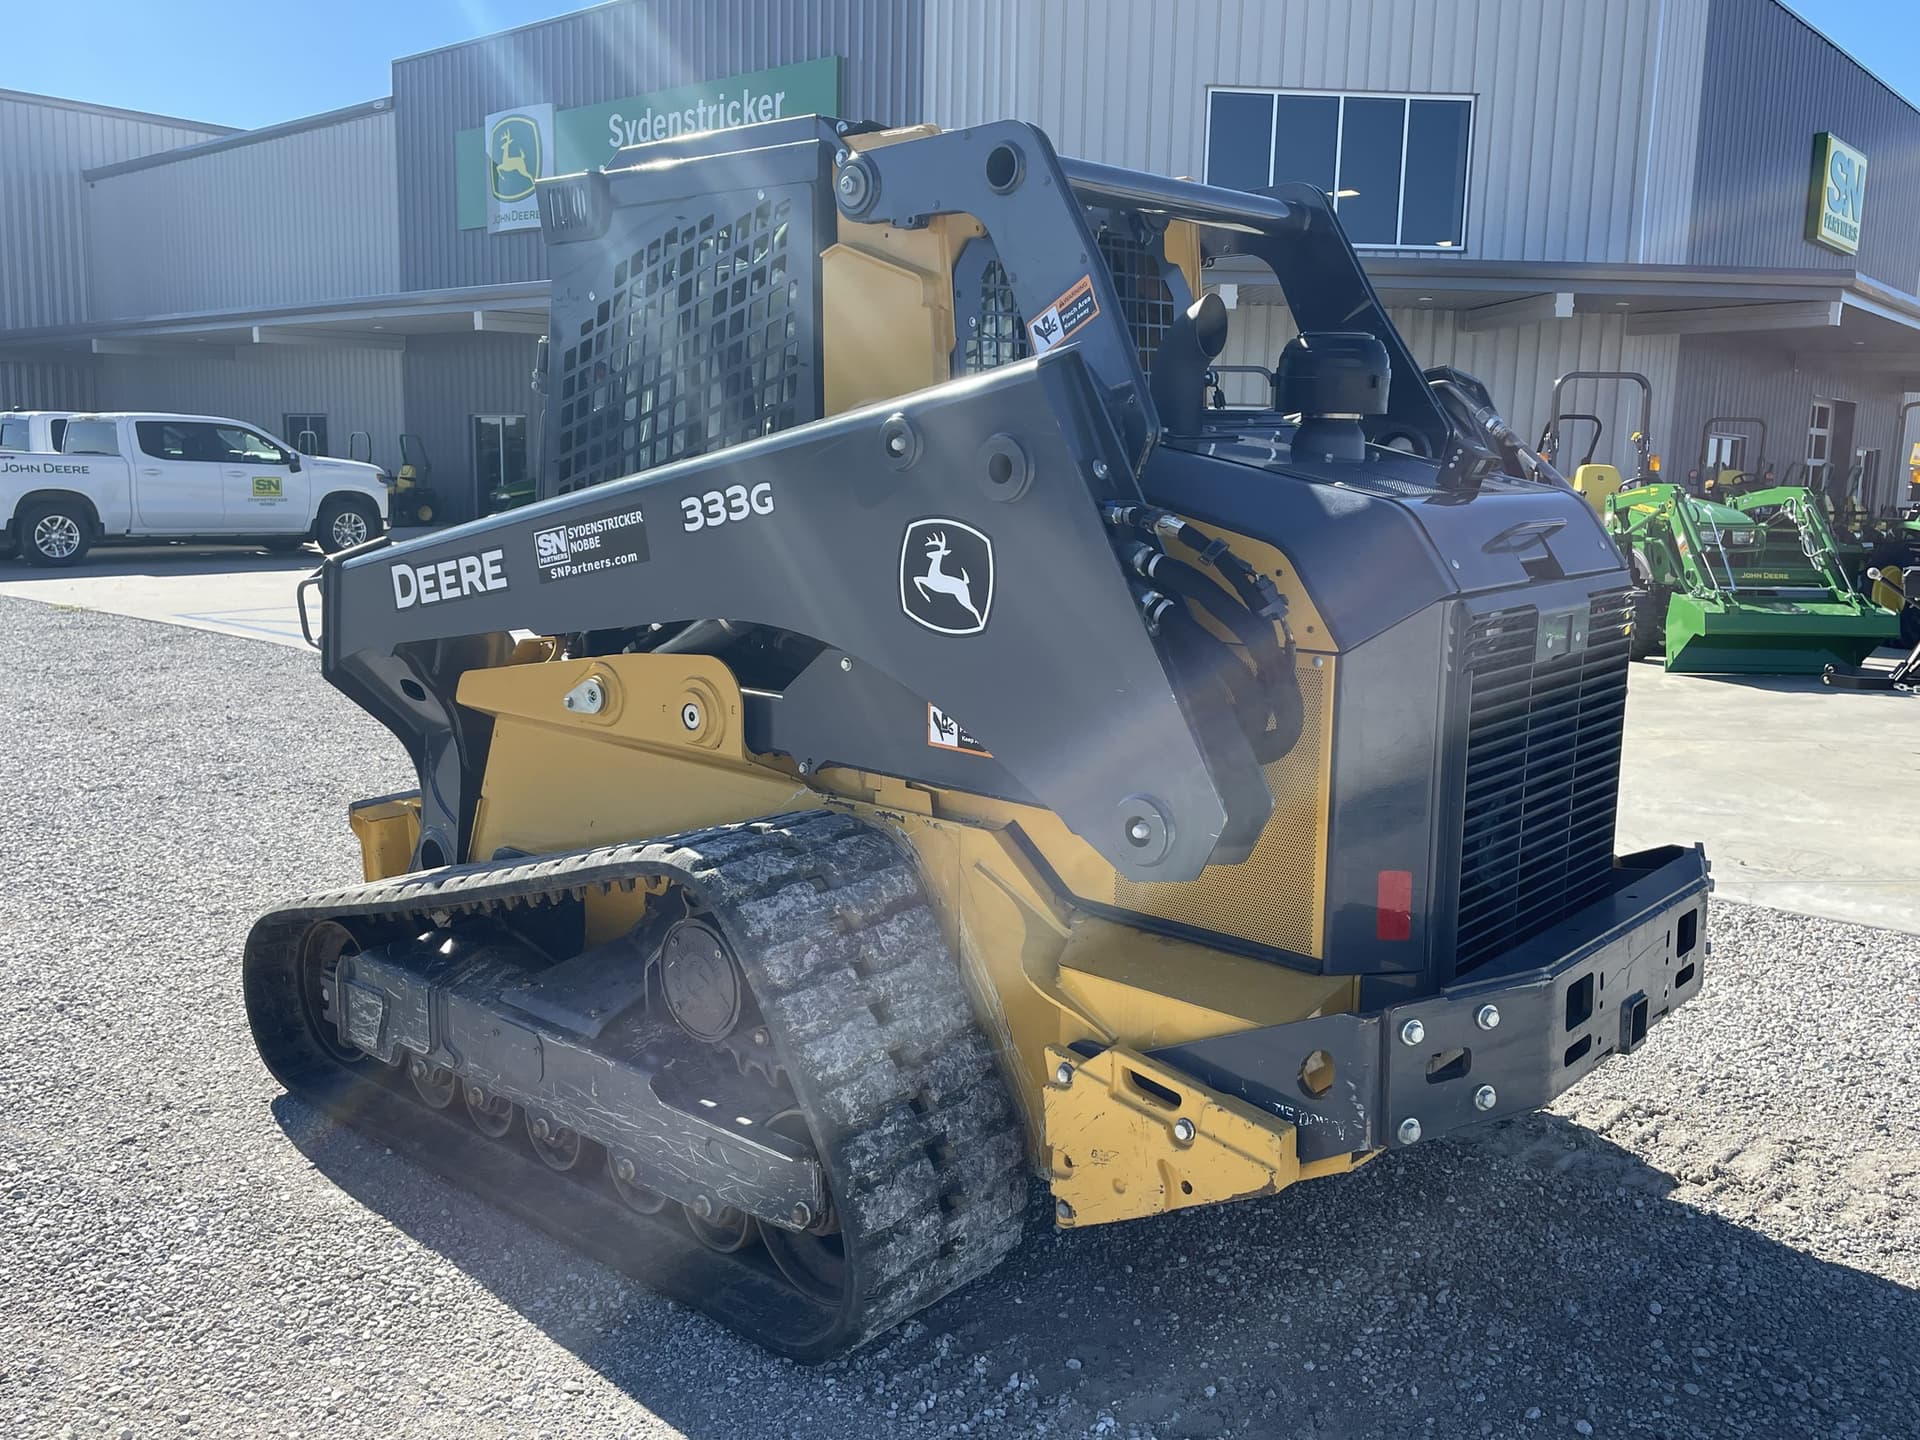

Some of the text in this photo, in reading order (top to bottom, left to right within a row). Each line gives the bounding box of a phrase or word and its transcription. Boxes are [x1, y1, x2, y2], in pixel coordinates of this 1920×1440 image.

[608, 89, 785, 148] Sydenstricker
[1827, 150, 1865, 223] SN
[1062, 296, 1091, 322] Pinch Area
[1, 462, 90, 475] JOHN DEERE
[255, 479, 280, 491] SN
[680, 482, 775, 532] 333G
[567, 510, 644, 539] SYDENSTRICKER
[537, 530, 567, 557] SN
[570, 535, 601, 554] NOBBE
[540, 552, 568, 564] PARTNERS
[550, 552, 638, 579] SNPartners.com
[391, 549, 508, 609] DEERE
